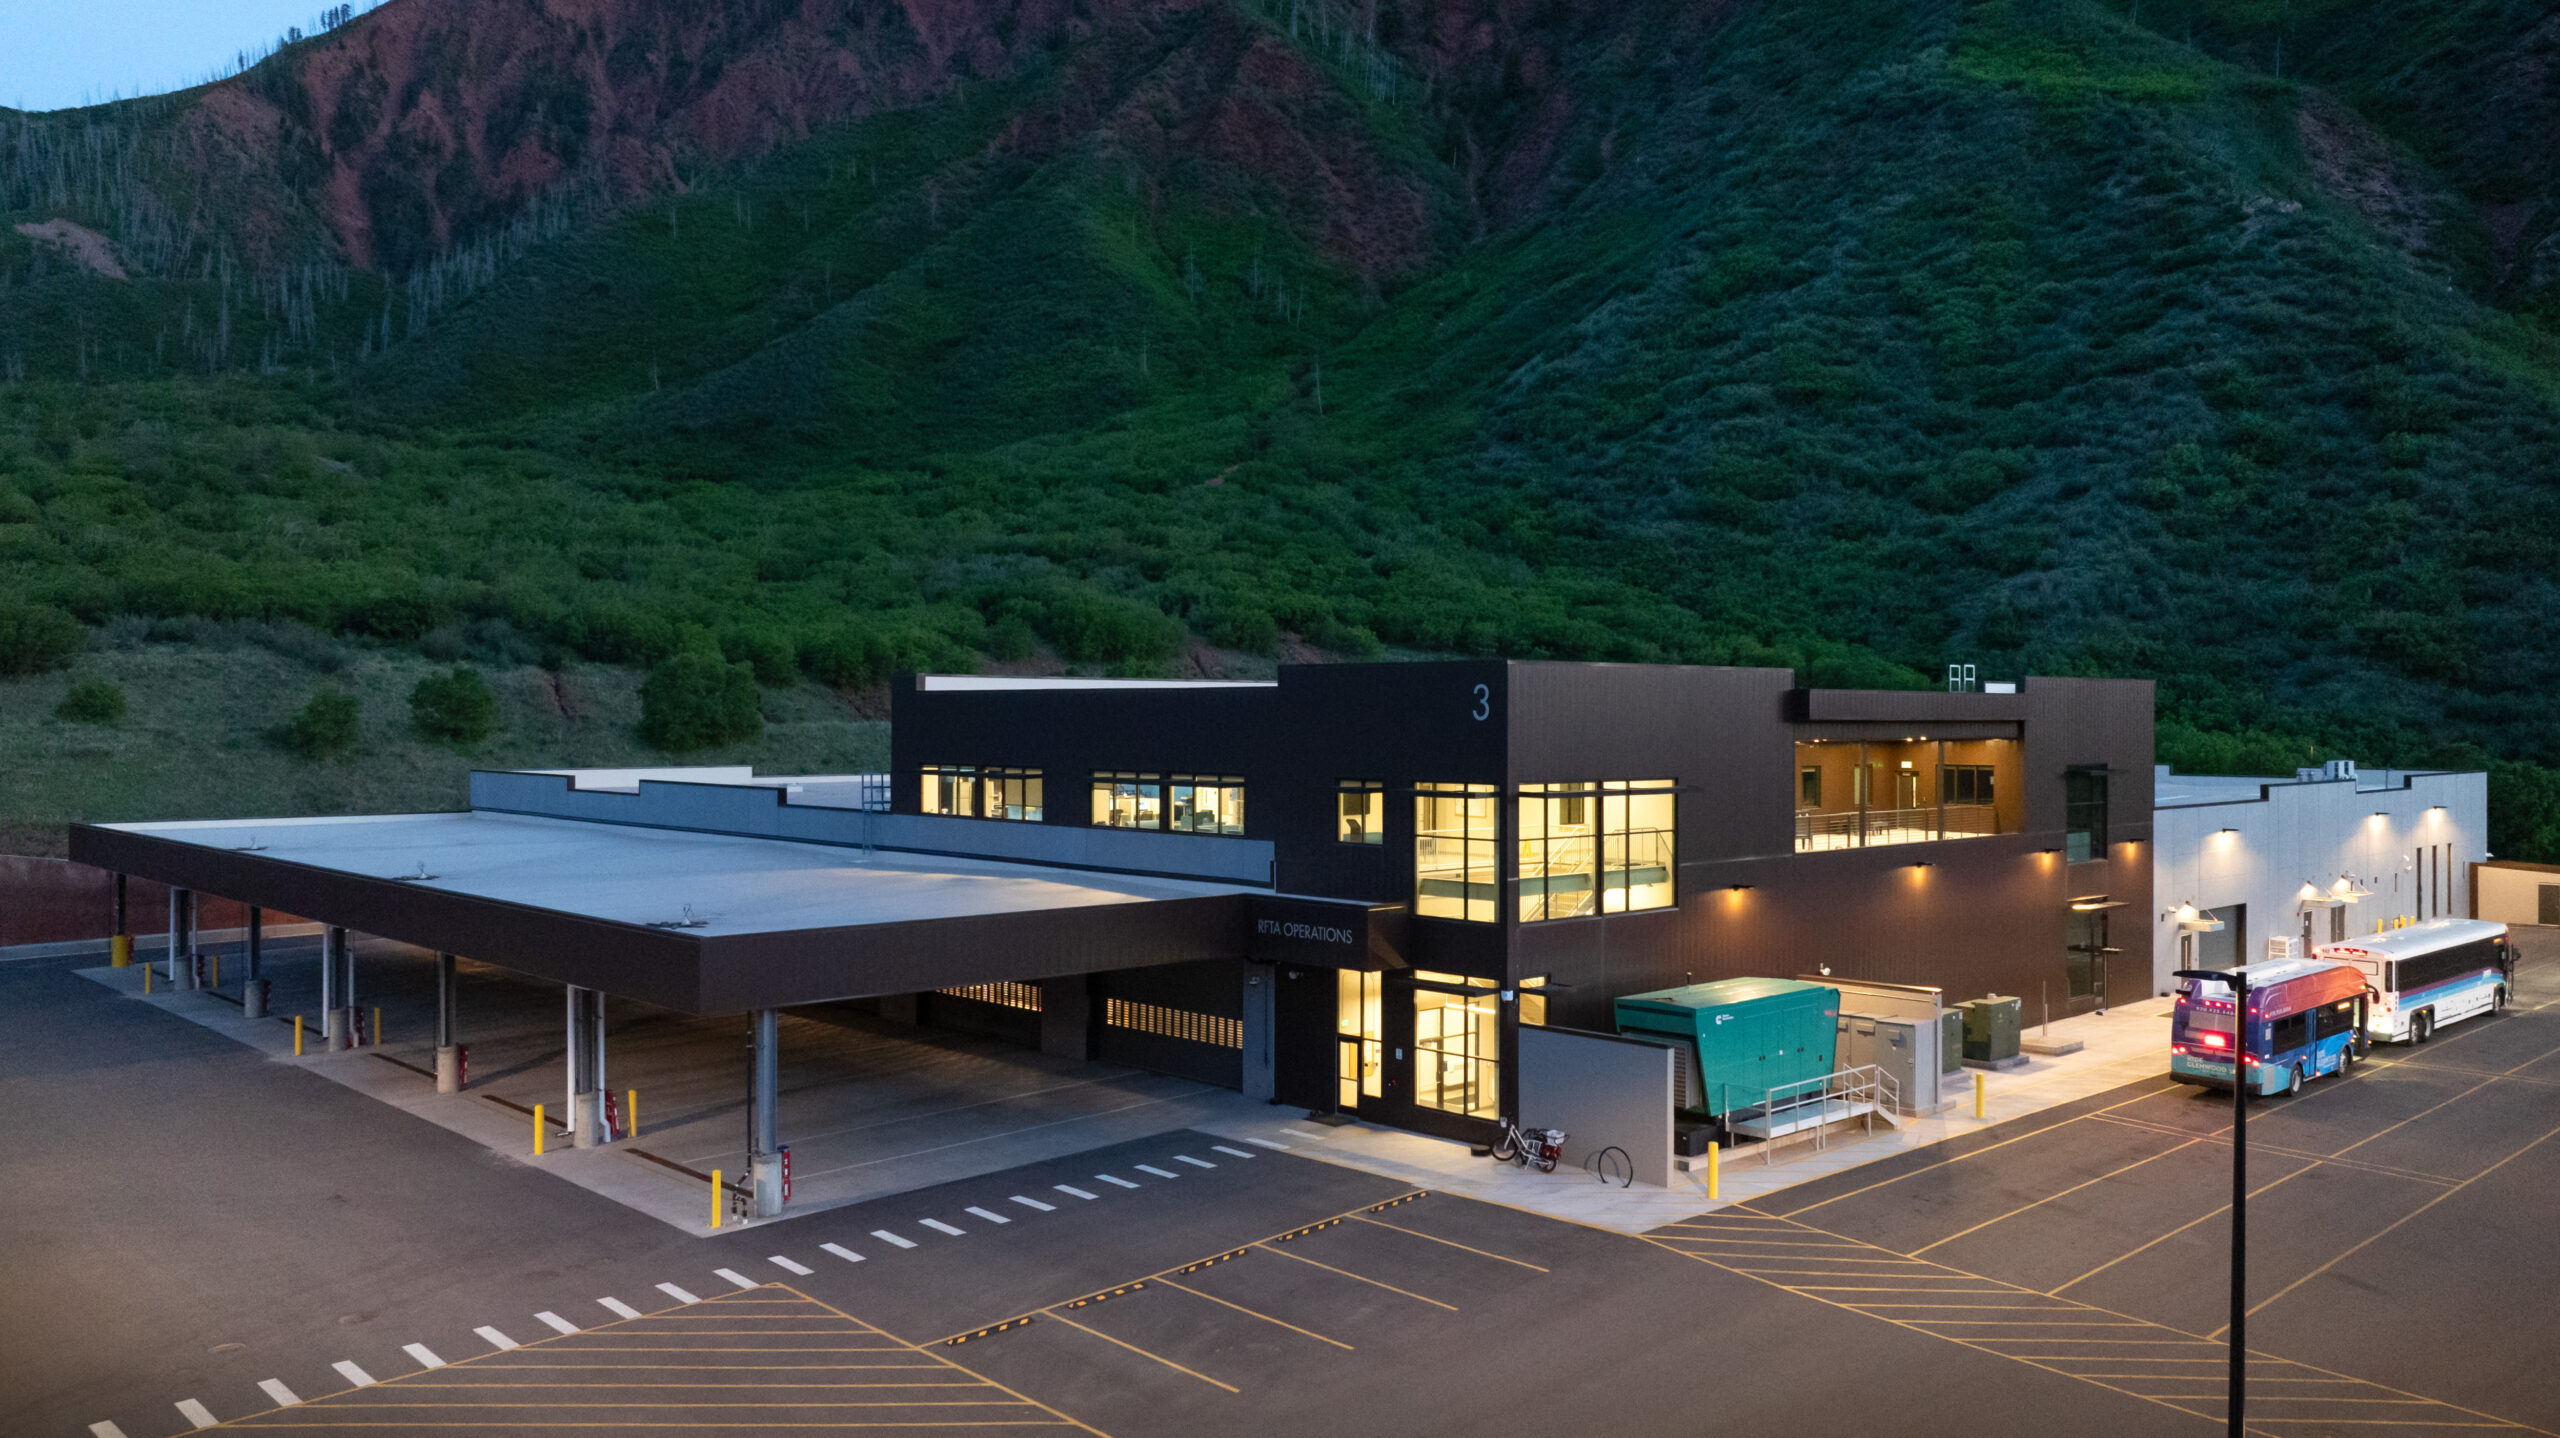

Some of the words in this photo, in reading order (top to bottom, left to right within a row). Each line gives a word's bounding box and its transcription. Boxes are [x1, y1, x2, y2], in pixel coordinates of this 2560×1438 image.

[1472, 683, 1490, 721] 3
[1258, 919, 1281, 935] RFTA
[1283, 922, 1353, 944] OPERATIONS
[2186, 1061, 2227, 1073] GLENWOOD
[2187, 1054, 2203, 1063] RIDE
